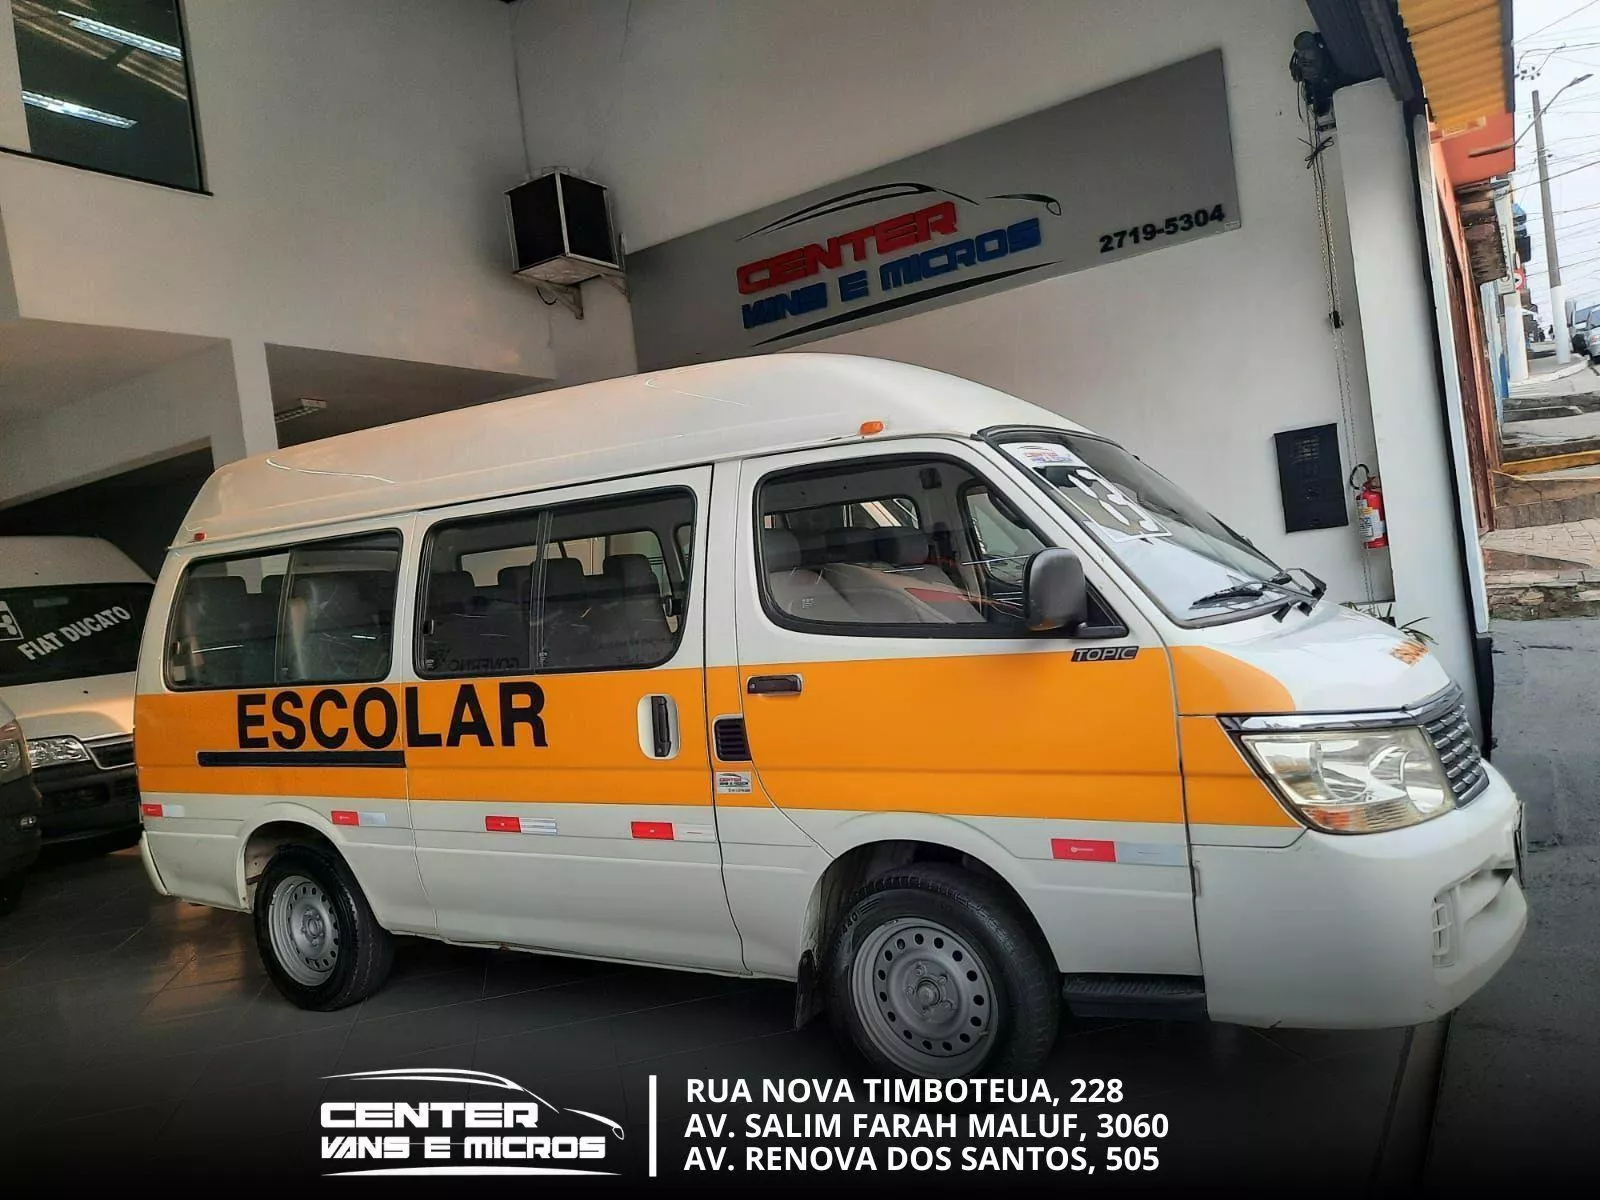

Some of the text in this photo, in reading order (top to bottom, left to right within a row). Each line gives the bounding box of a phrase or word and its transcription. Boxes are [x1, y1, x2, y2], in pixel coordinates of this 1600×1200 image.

[736, 200, 959, 295] CENTER
[1099, 203, 1226, 254] 2719-5304
[741, 216, 1042, 329] VANS E MICROS
[17, 606, 132, 661] FIAT DUCATO
[1074, 647, 1138, 662] TOPIC
[237, 681, 549, 750] ESCOLAR
